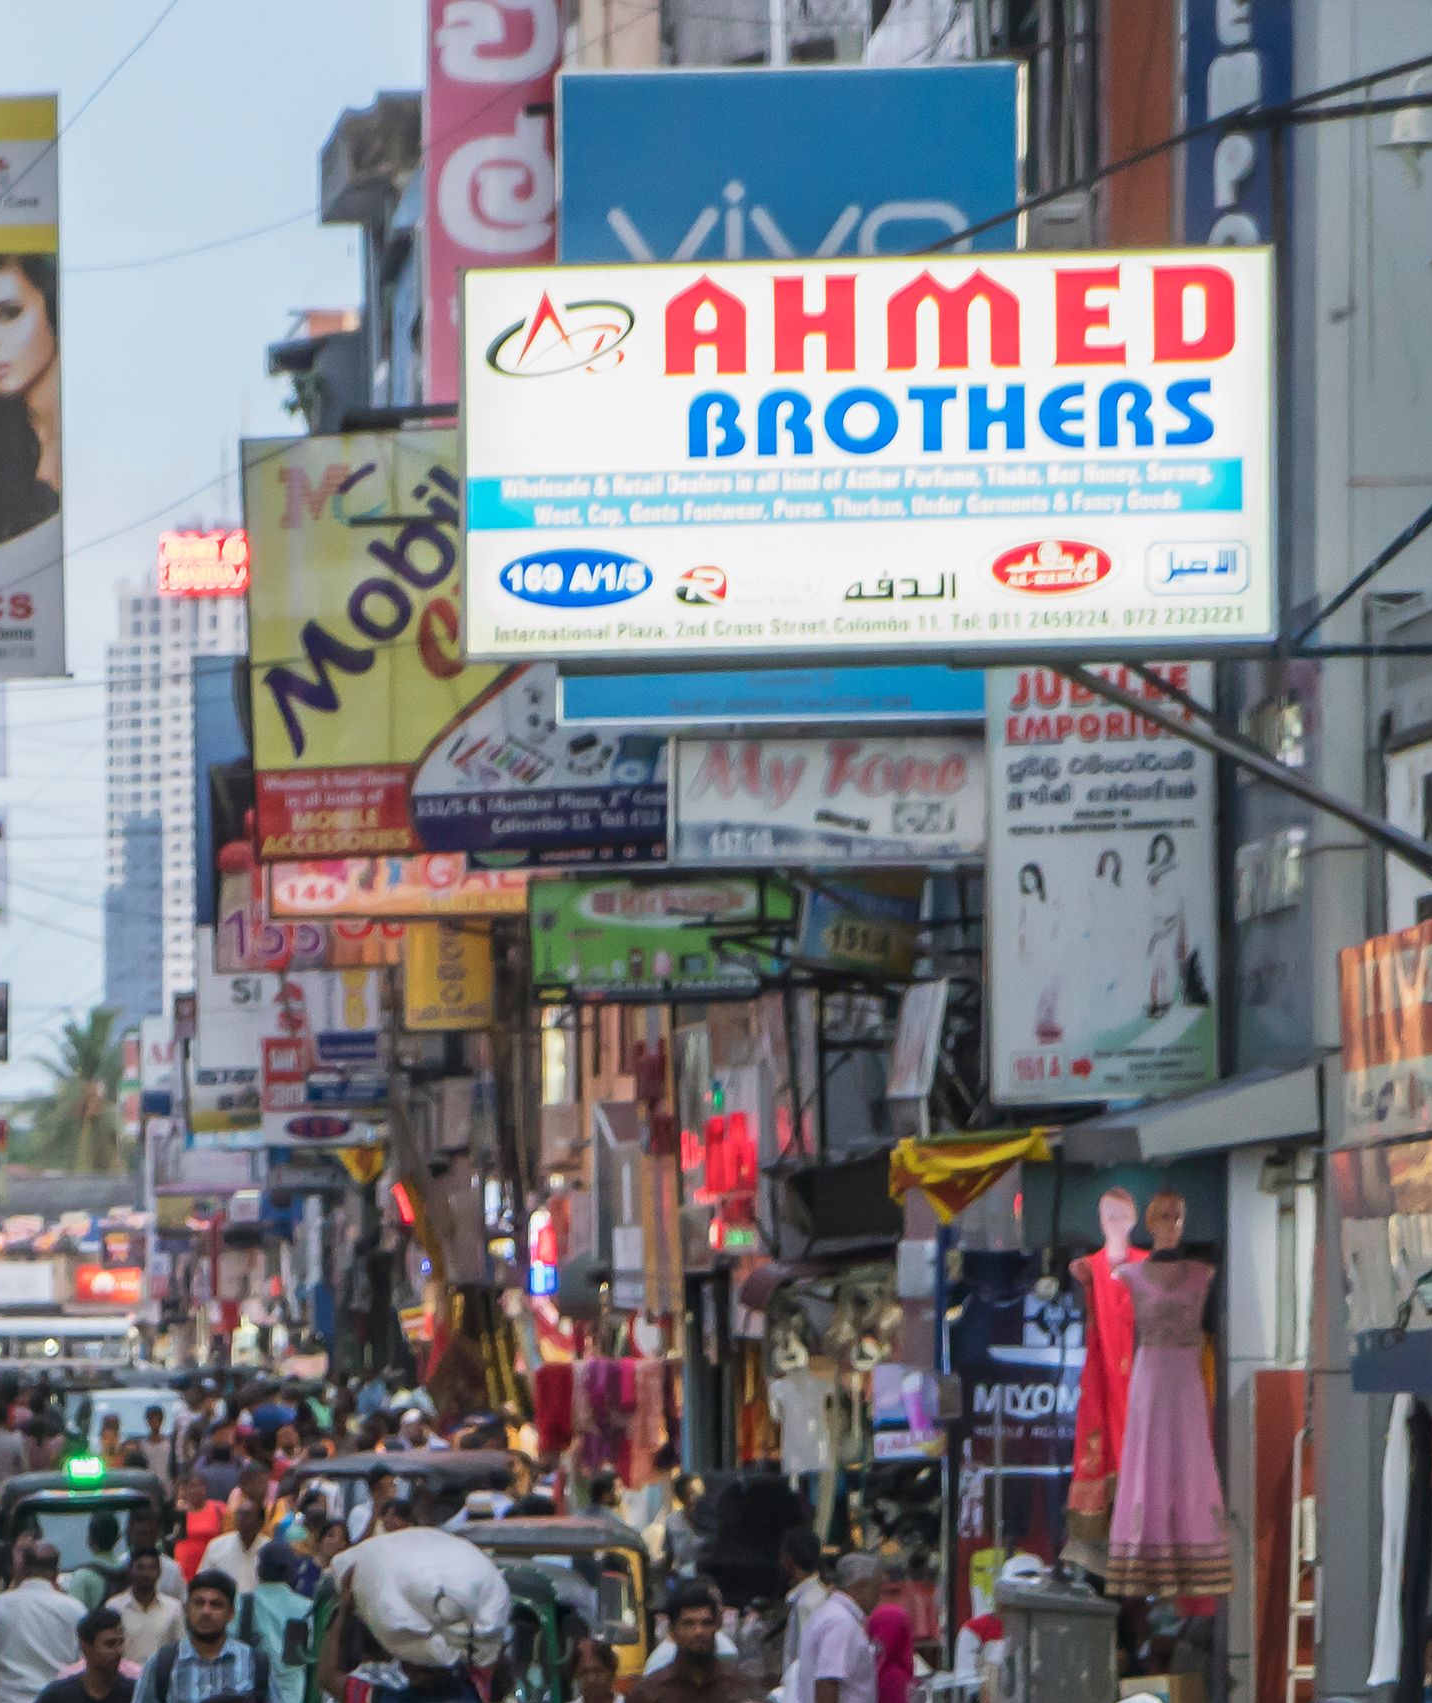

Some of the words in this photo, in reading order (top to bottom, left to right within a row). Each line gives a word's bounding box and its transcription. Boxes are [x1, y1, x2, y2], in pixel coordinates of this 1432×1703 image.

[663, 264, 1237, 378] AHMED
[688, 378, 1216, 459] BROTHERS
[506, 562, 564, 593] 169
[675, 620, 709, 640] 2nd
[714, 619, 765, 639] Cross
[832, 615, 909, 635] Colombo
